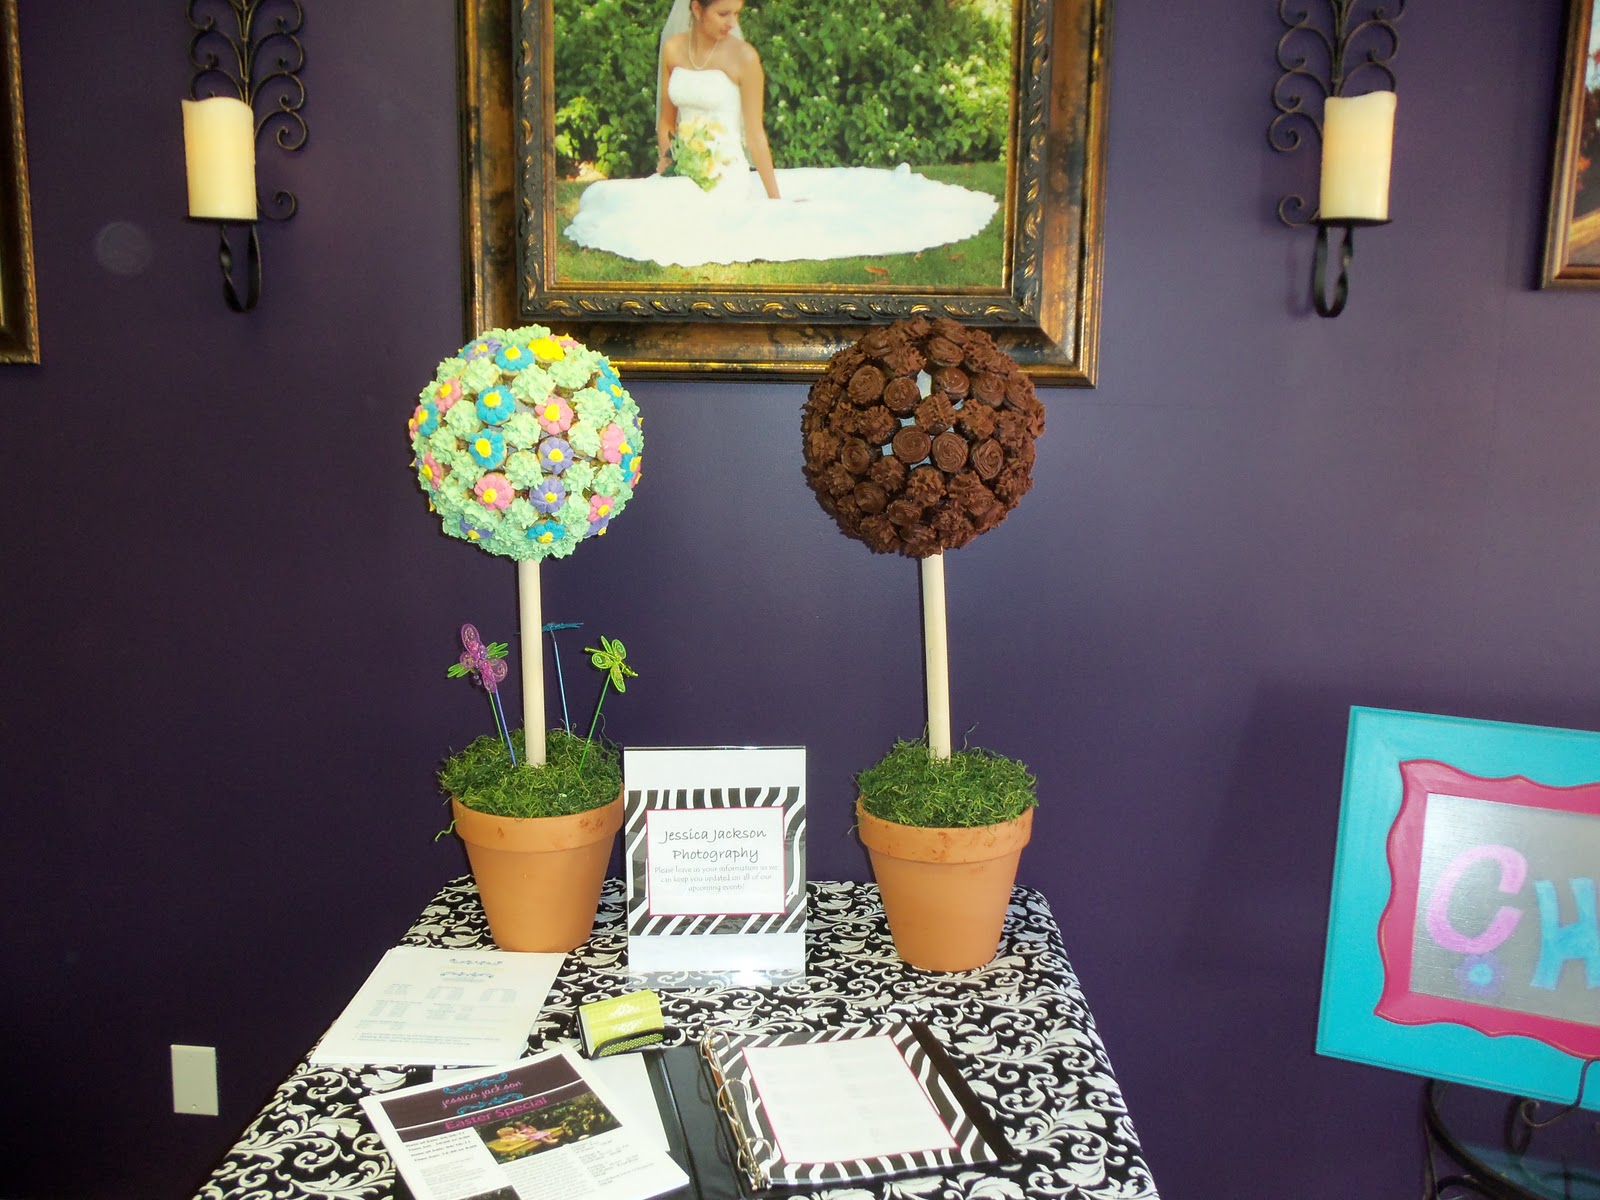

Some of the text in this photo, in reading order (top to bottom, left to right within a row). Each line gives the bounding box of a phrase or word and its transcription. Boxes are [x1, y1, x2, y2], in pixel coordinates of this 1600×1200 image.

[657, 827, 767, 845] Jessica Jackson
[672, 846, 759, 864] Photography
[654, 865, 675, 874] Please
[675, 865, 692, 873] leave
[718, 864, 759, 872] information
[673, 875, 689, 884] keep
[704, 874, 731, 883] updated
[688, 884, 721, 893] upcoming
[441, 1091, 480, 1108] jessica
[444, 1096, 549, 1130] Easter Special
